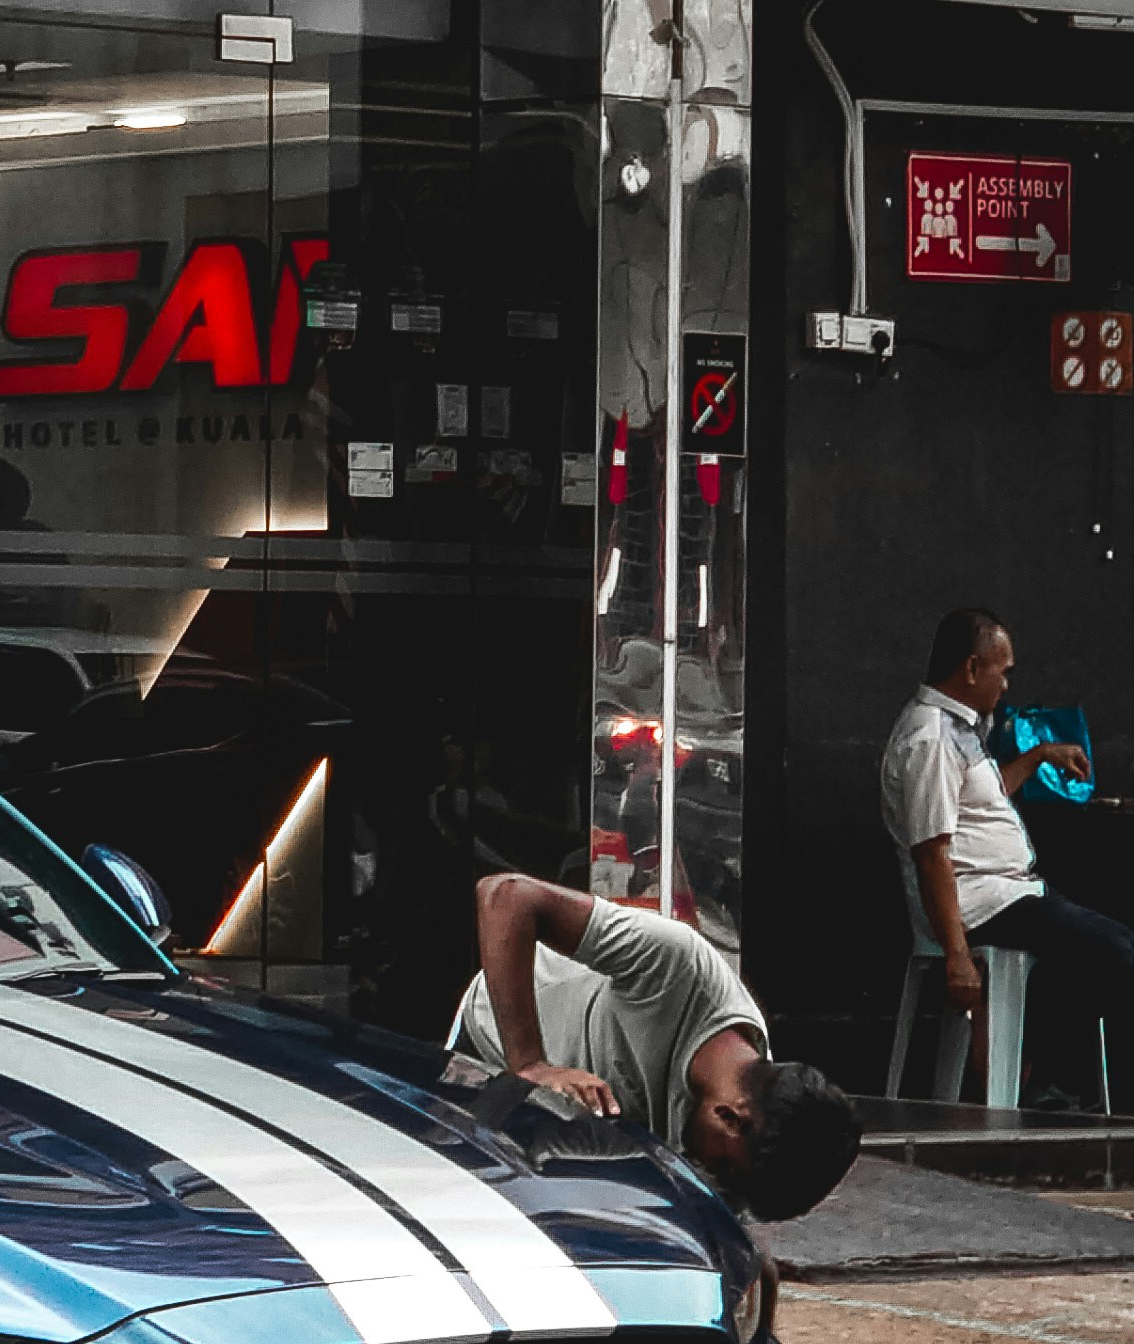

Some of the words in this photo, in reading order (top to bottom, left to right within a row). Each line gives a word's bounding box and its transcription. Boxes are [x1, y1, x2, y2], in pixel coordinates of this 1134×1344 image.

[977, 176, 1064, 200] ASSEMBLY
[977, 199, 1030, 220] POINT
[3, 419, 122, 449] HOTEL
